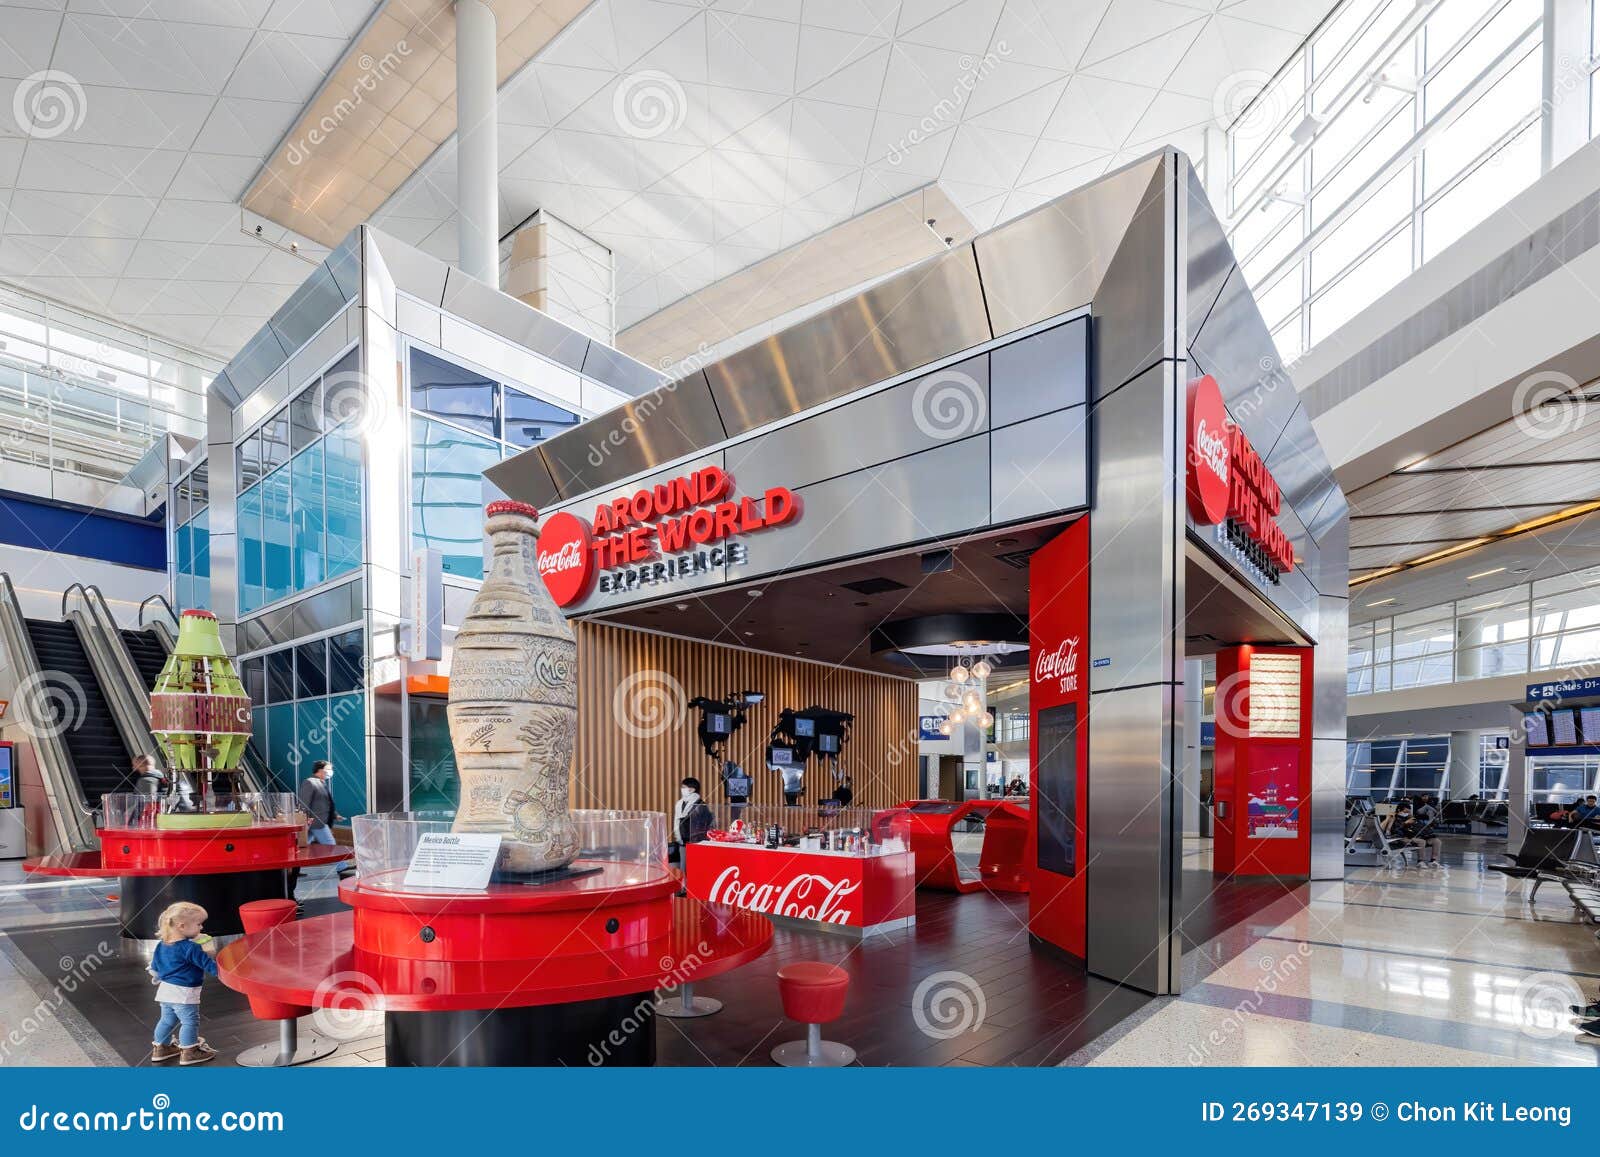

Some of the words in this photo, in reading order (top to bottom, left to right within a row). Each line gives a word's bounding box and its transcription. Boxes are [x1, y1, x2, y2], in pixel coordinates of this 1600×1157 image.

[592, 466, 730, 536] AROUND
[592, 529, 655, 570] THE
[656, 487, 798, 553] WORLD
[600, 543, 742, 593] EXPERIENCE
[1060, 674, 1078, 694] STORE
[1555, 683, 1582, 692] Gates
